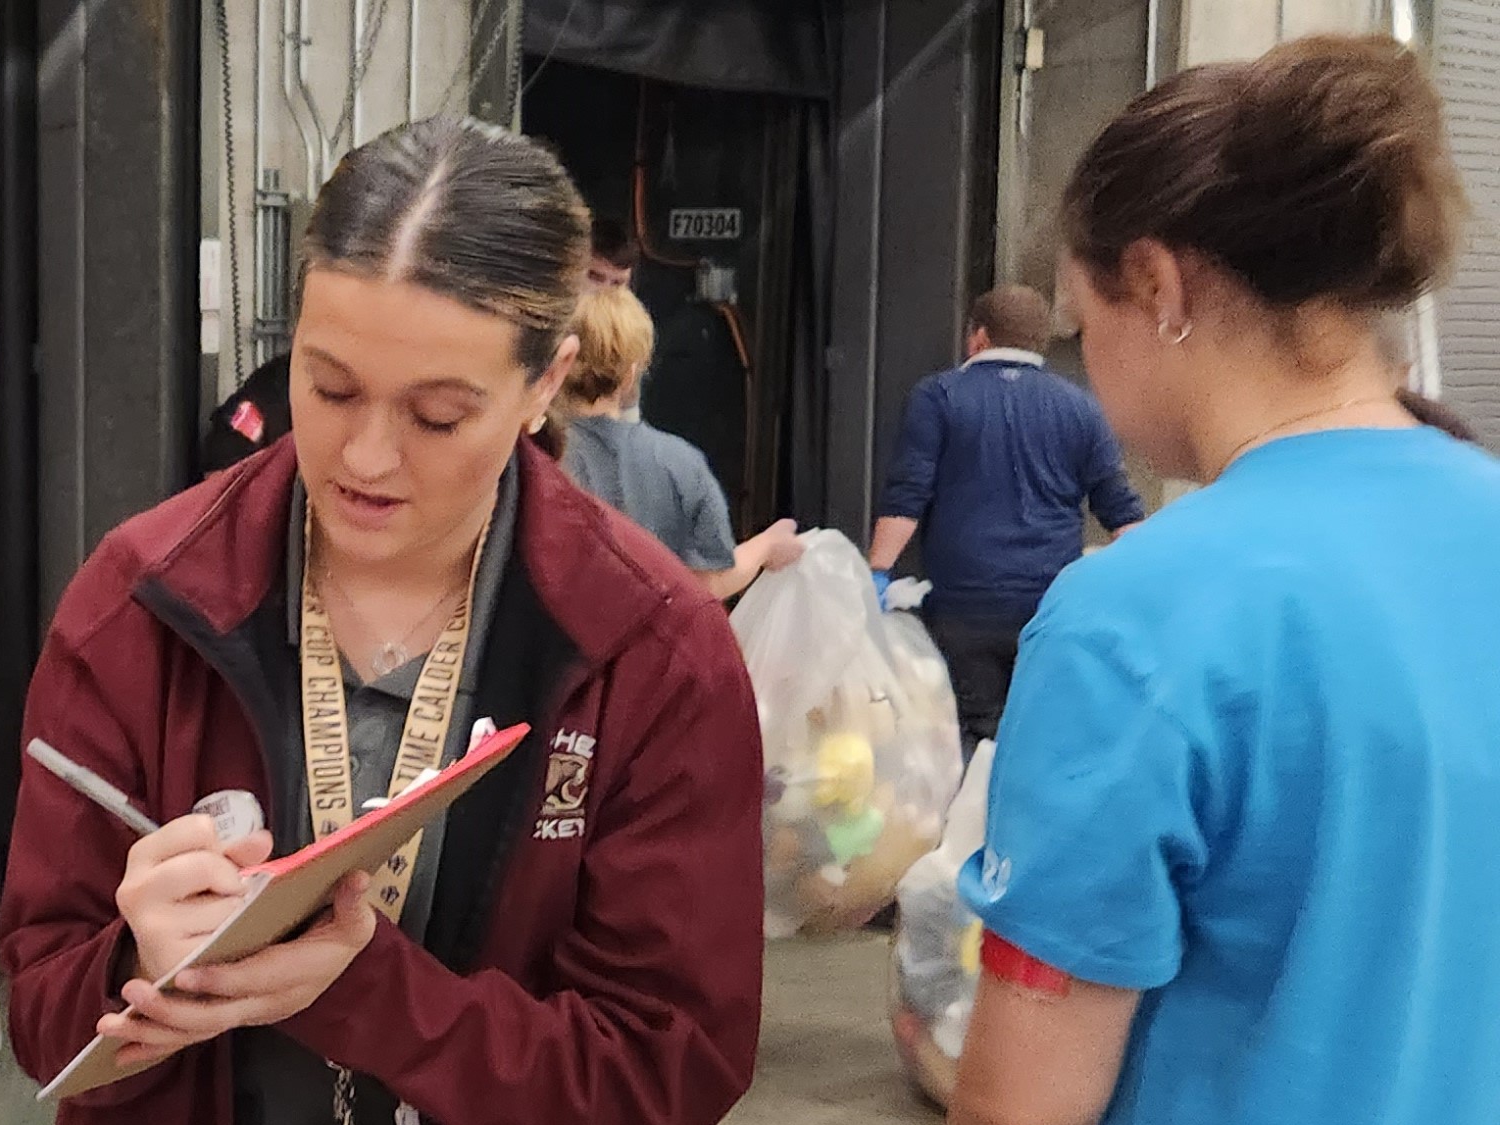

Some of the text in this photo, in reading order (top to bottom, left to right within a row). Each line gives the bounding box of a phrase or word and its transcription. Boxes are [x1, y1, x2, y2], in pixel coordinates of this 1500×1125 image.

[673, 212, 736, 236] F70304
[305, 624, 334, 667] CUP
[412, 641, 462, 722] CALDER
[308, 677, 347, 811] CHAMPIONS
